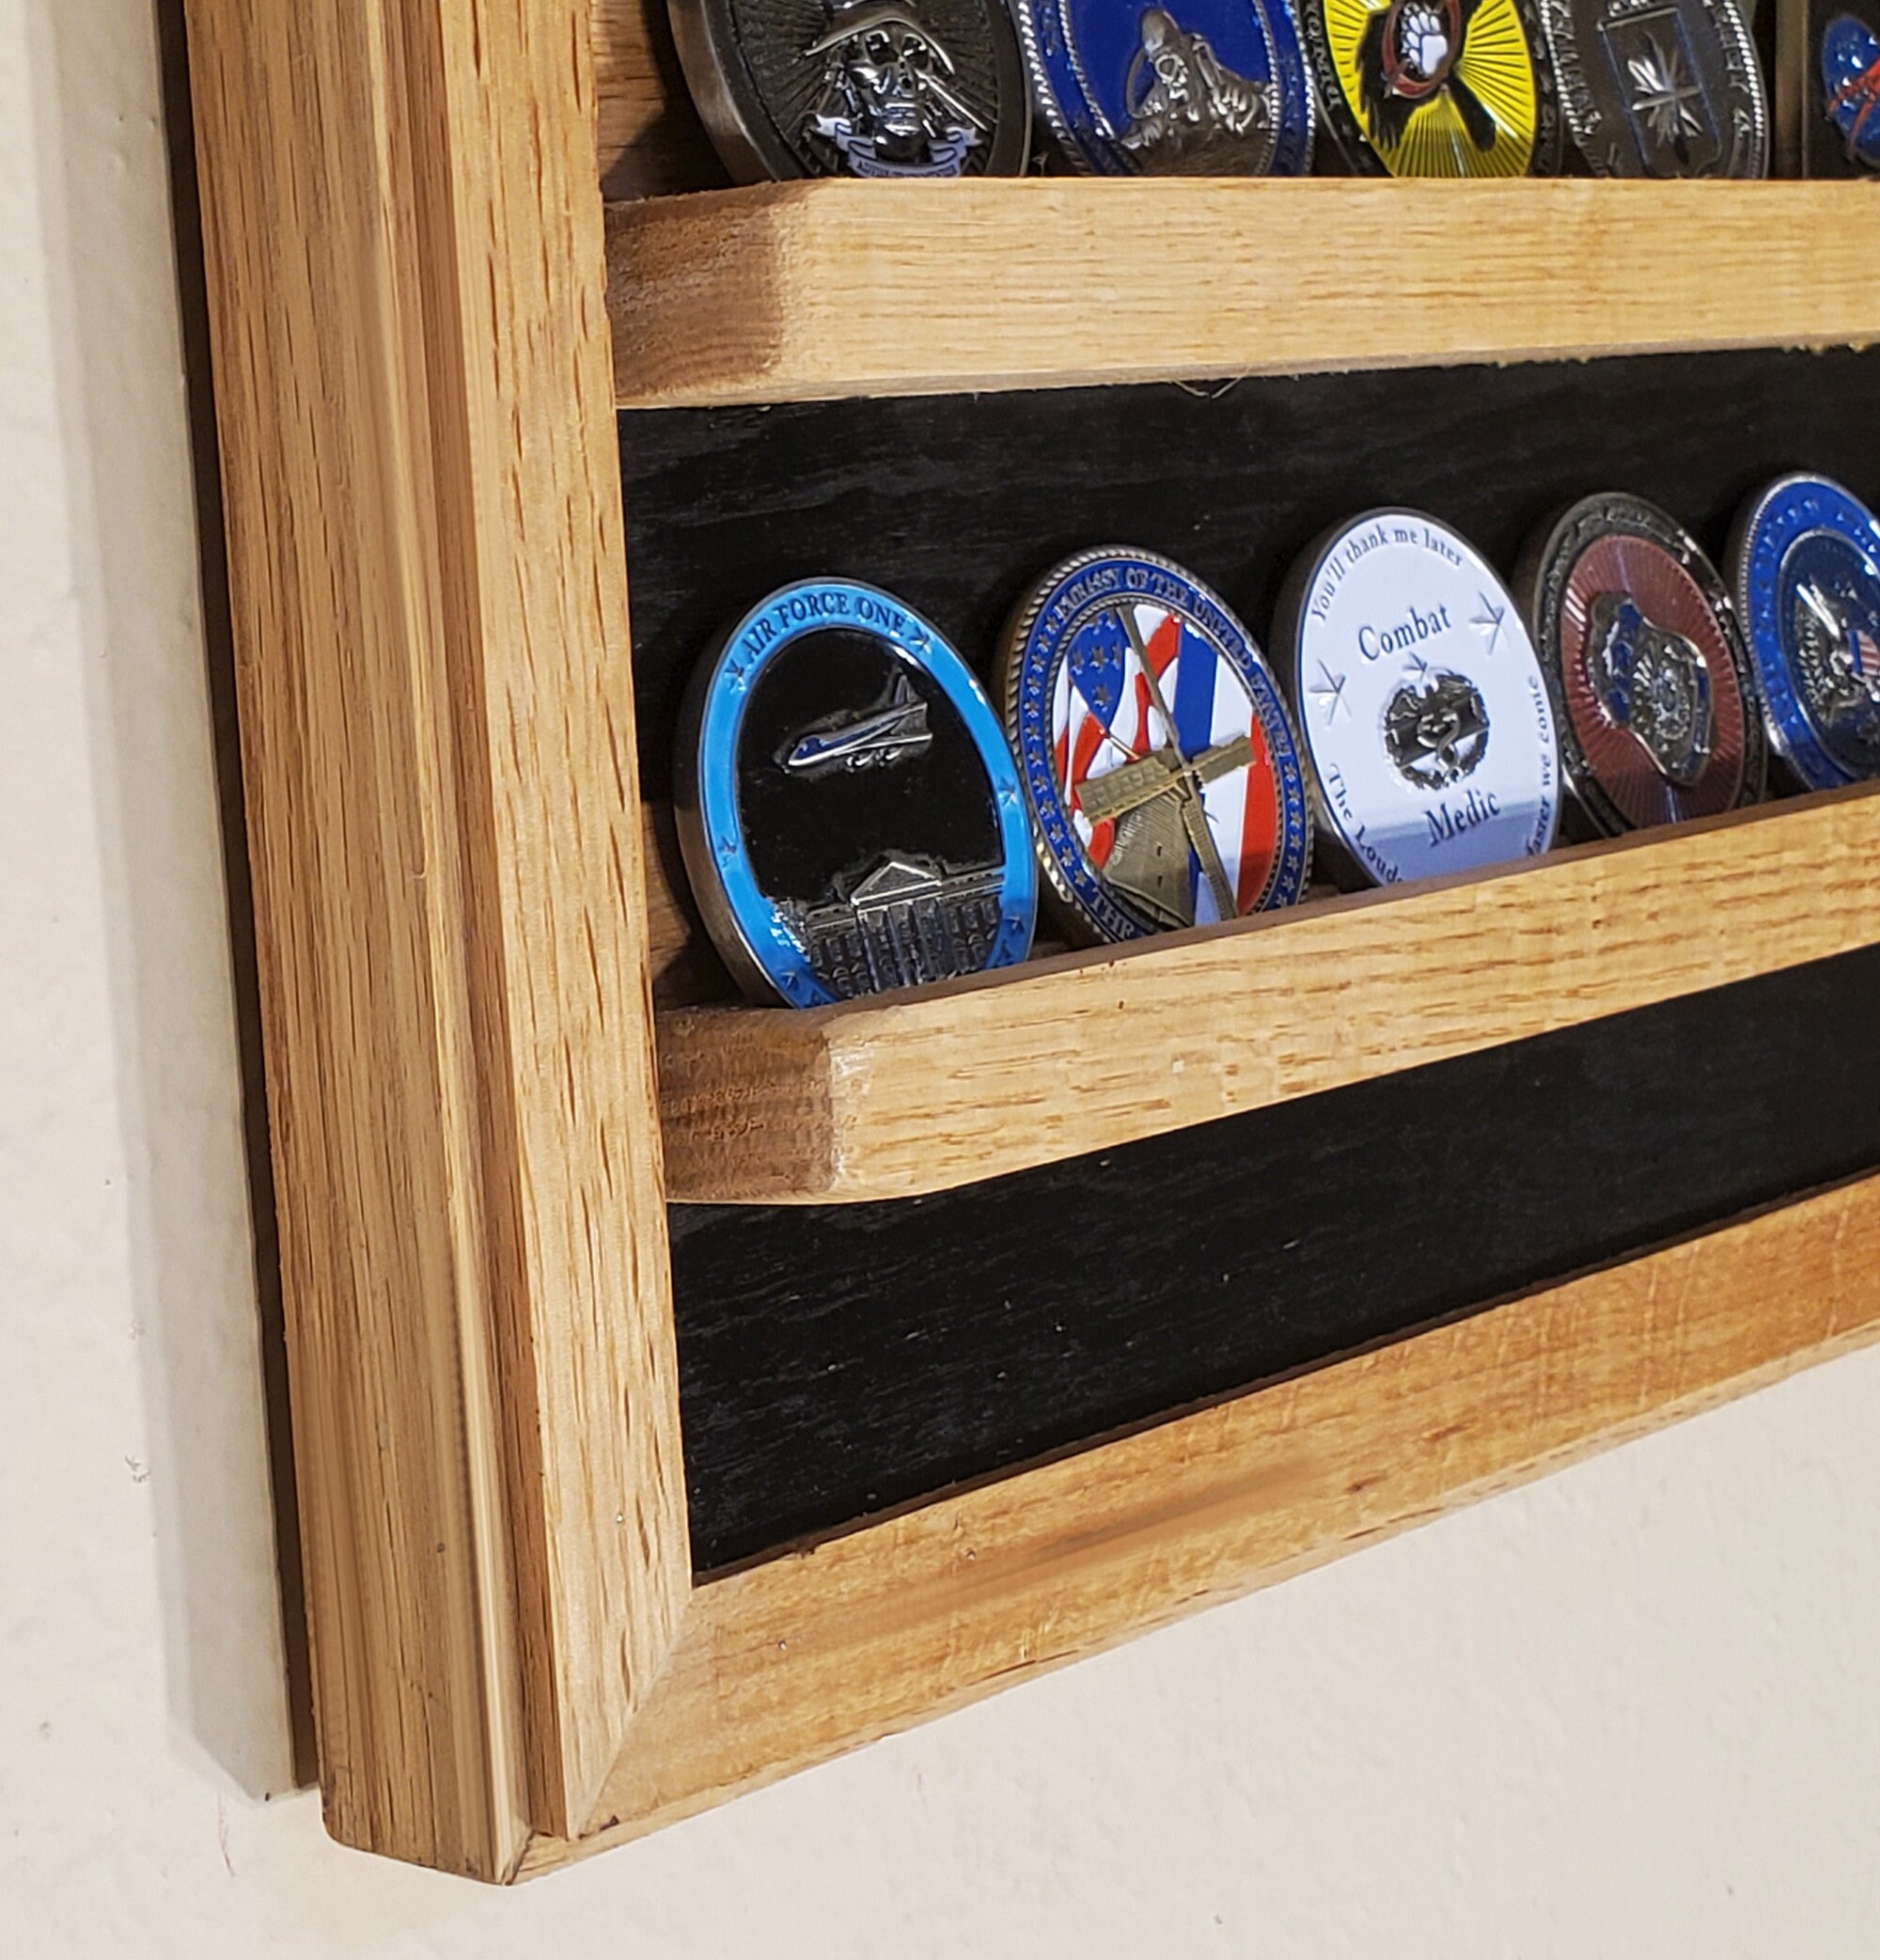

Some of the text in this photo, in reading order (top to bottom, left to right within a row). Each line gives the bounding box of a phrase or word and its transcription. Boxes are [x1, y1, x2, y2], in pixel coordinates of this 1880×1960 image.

[1310, 524, 1463, 621] You'll thank me later
[743, 592, 905, 661] AIR FORCE ONE
[1358, 604, 1452, 661] Combat
[1053, 567, 1292, 758] EMBASSY OF THE UNITED STATES
[1528, 675, 1549, 745] come
[1327, 763, 1354, 821] The
[1542, 754, 1551, 786] we
[1424, 791, 1501, 847] Medic
